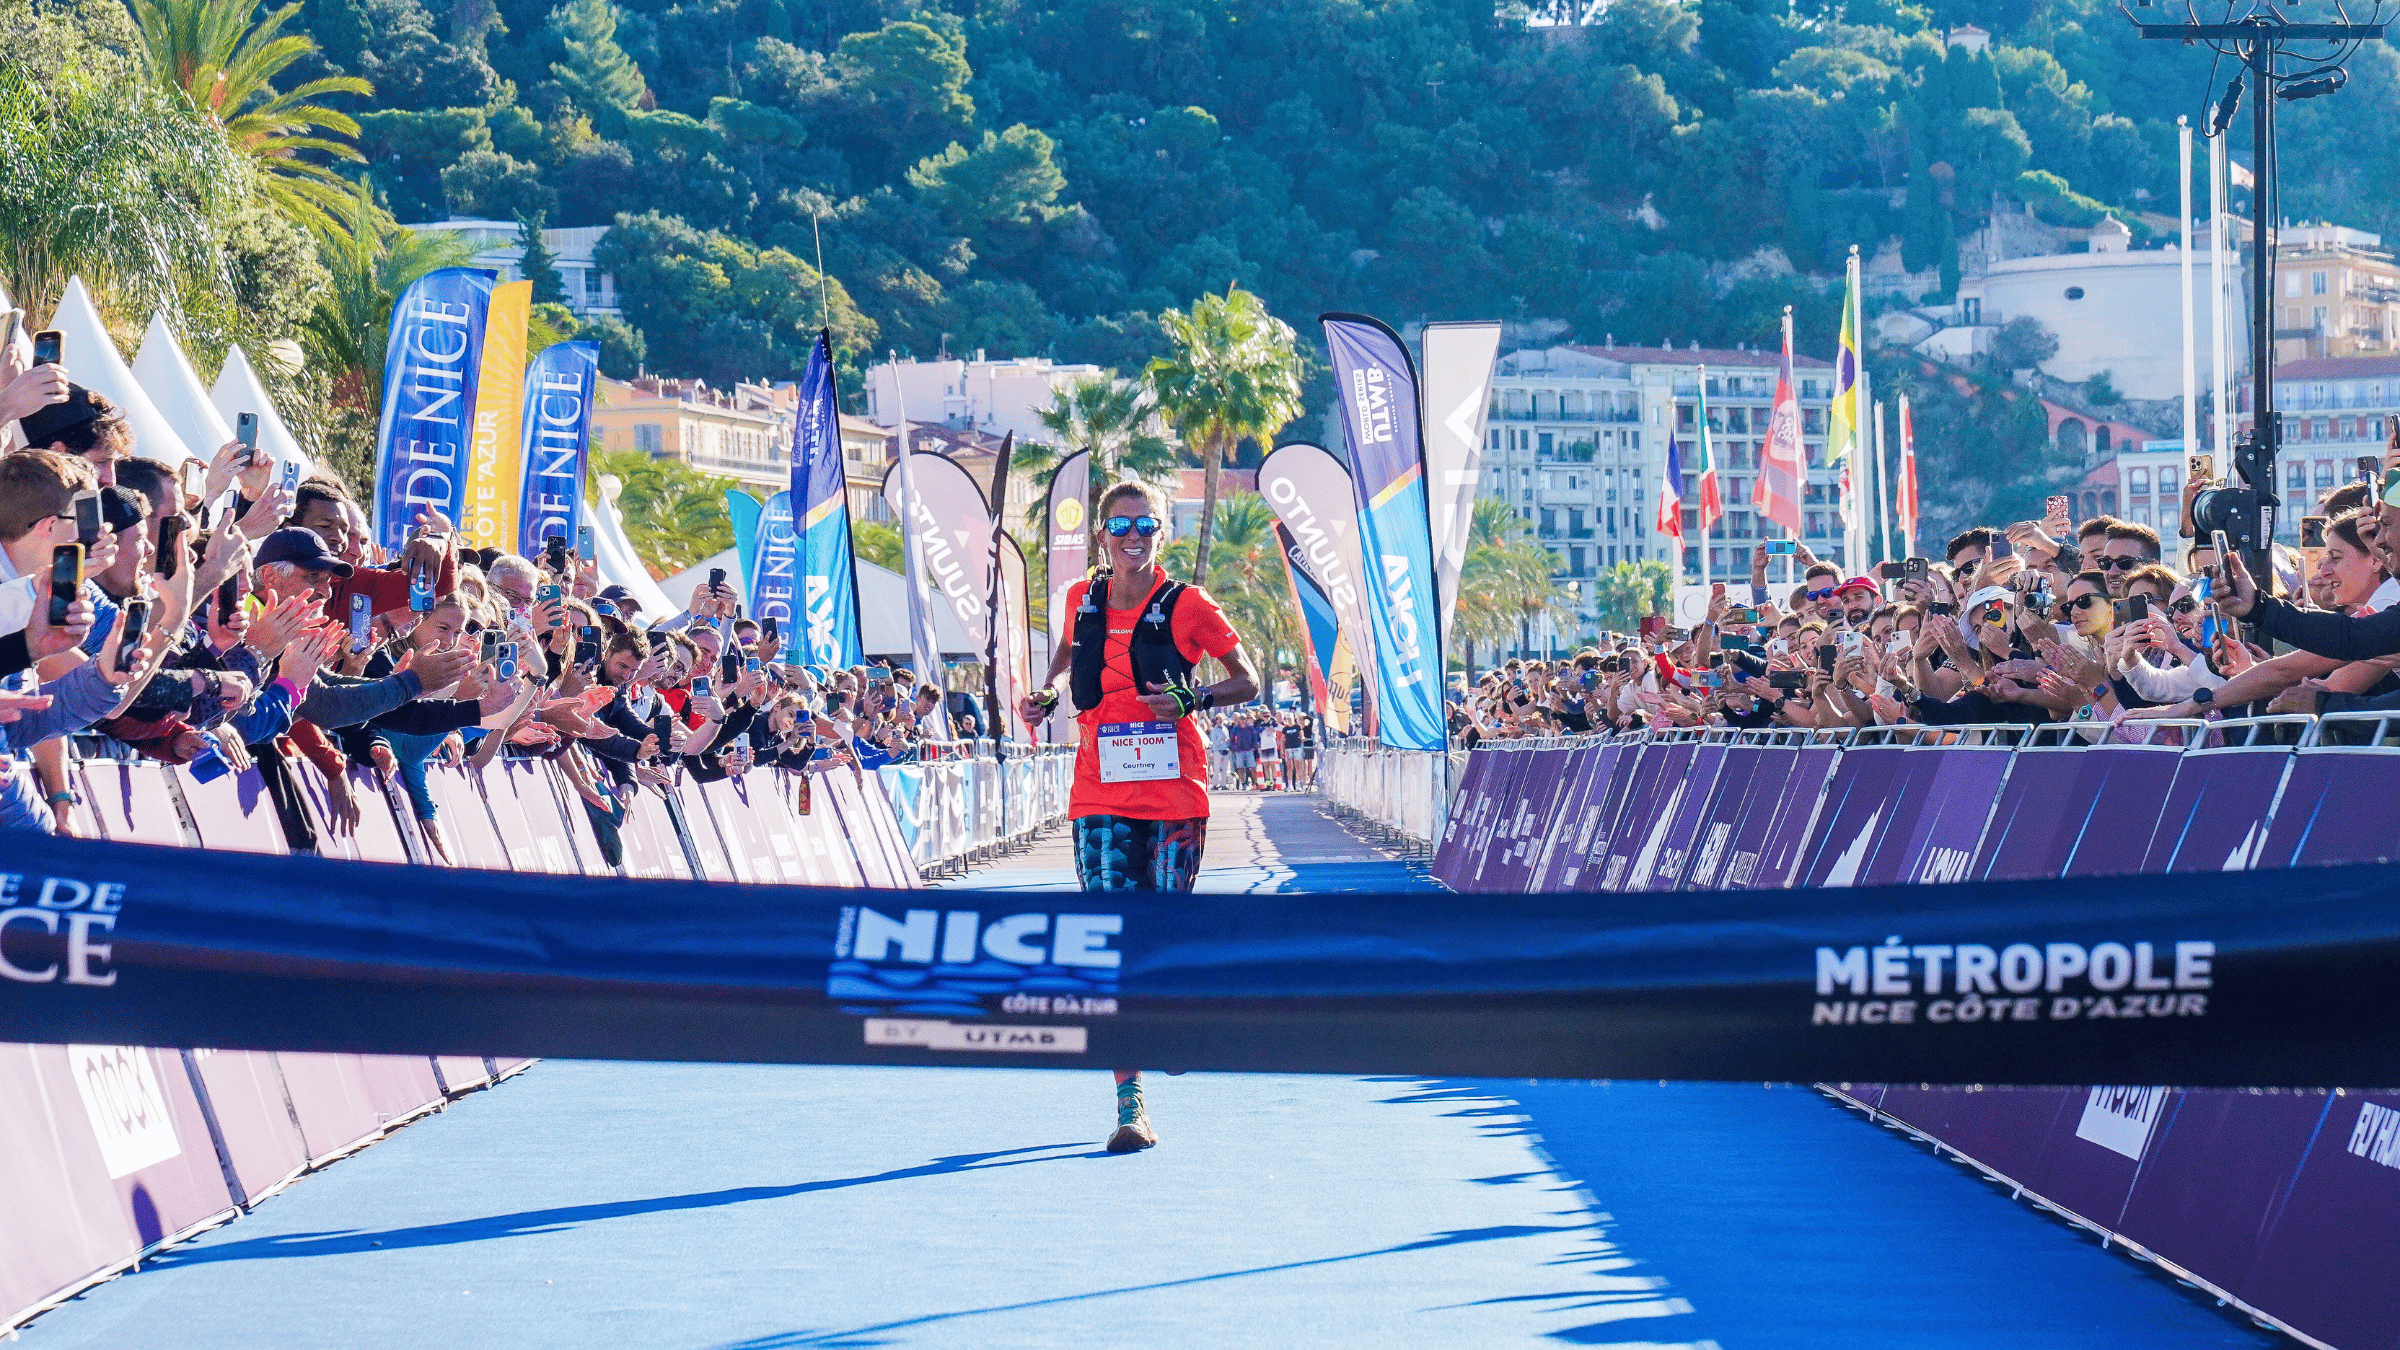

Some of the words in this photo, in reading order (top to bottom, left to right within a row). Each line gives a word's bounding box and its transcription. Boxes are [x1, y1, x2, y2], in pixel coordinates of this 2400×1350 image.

[411, 299, 470, 429] NICE
[540, 371, 582, 478] NICE
[405, 439, 457, 511] DE
[539, 493, 573, 551] DE
[767, 510, 795, 577] NICE
[1053, 533, 1085, 545] SIDAS
[764, 586, 792, 624] DE
[1112, 738, 1134, 747] NICE
[1138, 736, 1165, 746] 100M
[1134, 747, 1141, 760] 1
[37, 876, 126, 913] DE
[0, 907, 117, 986] CE
[853, 906, 1124, 968] NICE
[1814, 935, 2216, 995] MÉTROPOLE
[1811, 1001, 1916, 1025] NICE
[1926, 993, 2041, 1023] CÔTE
[2050, 993, 2208, 1021] D'AZUR
